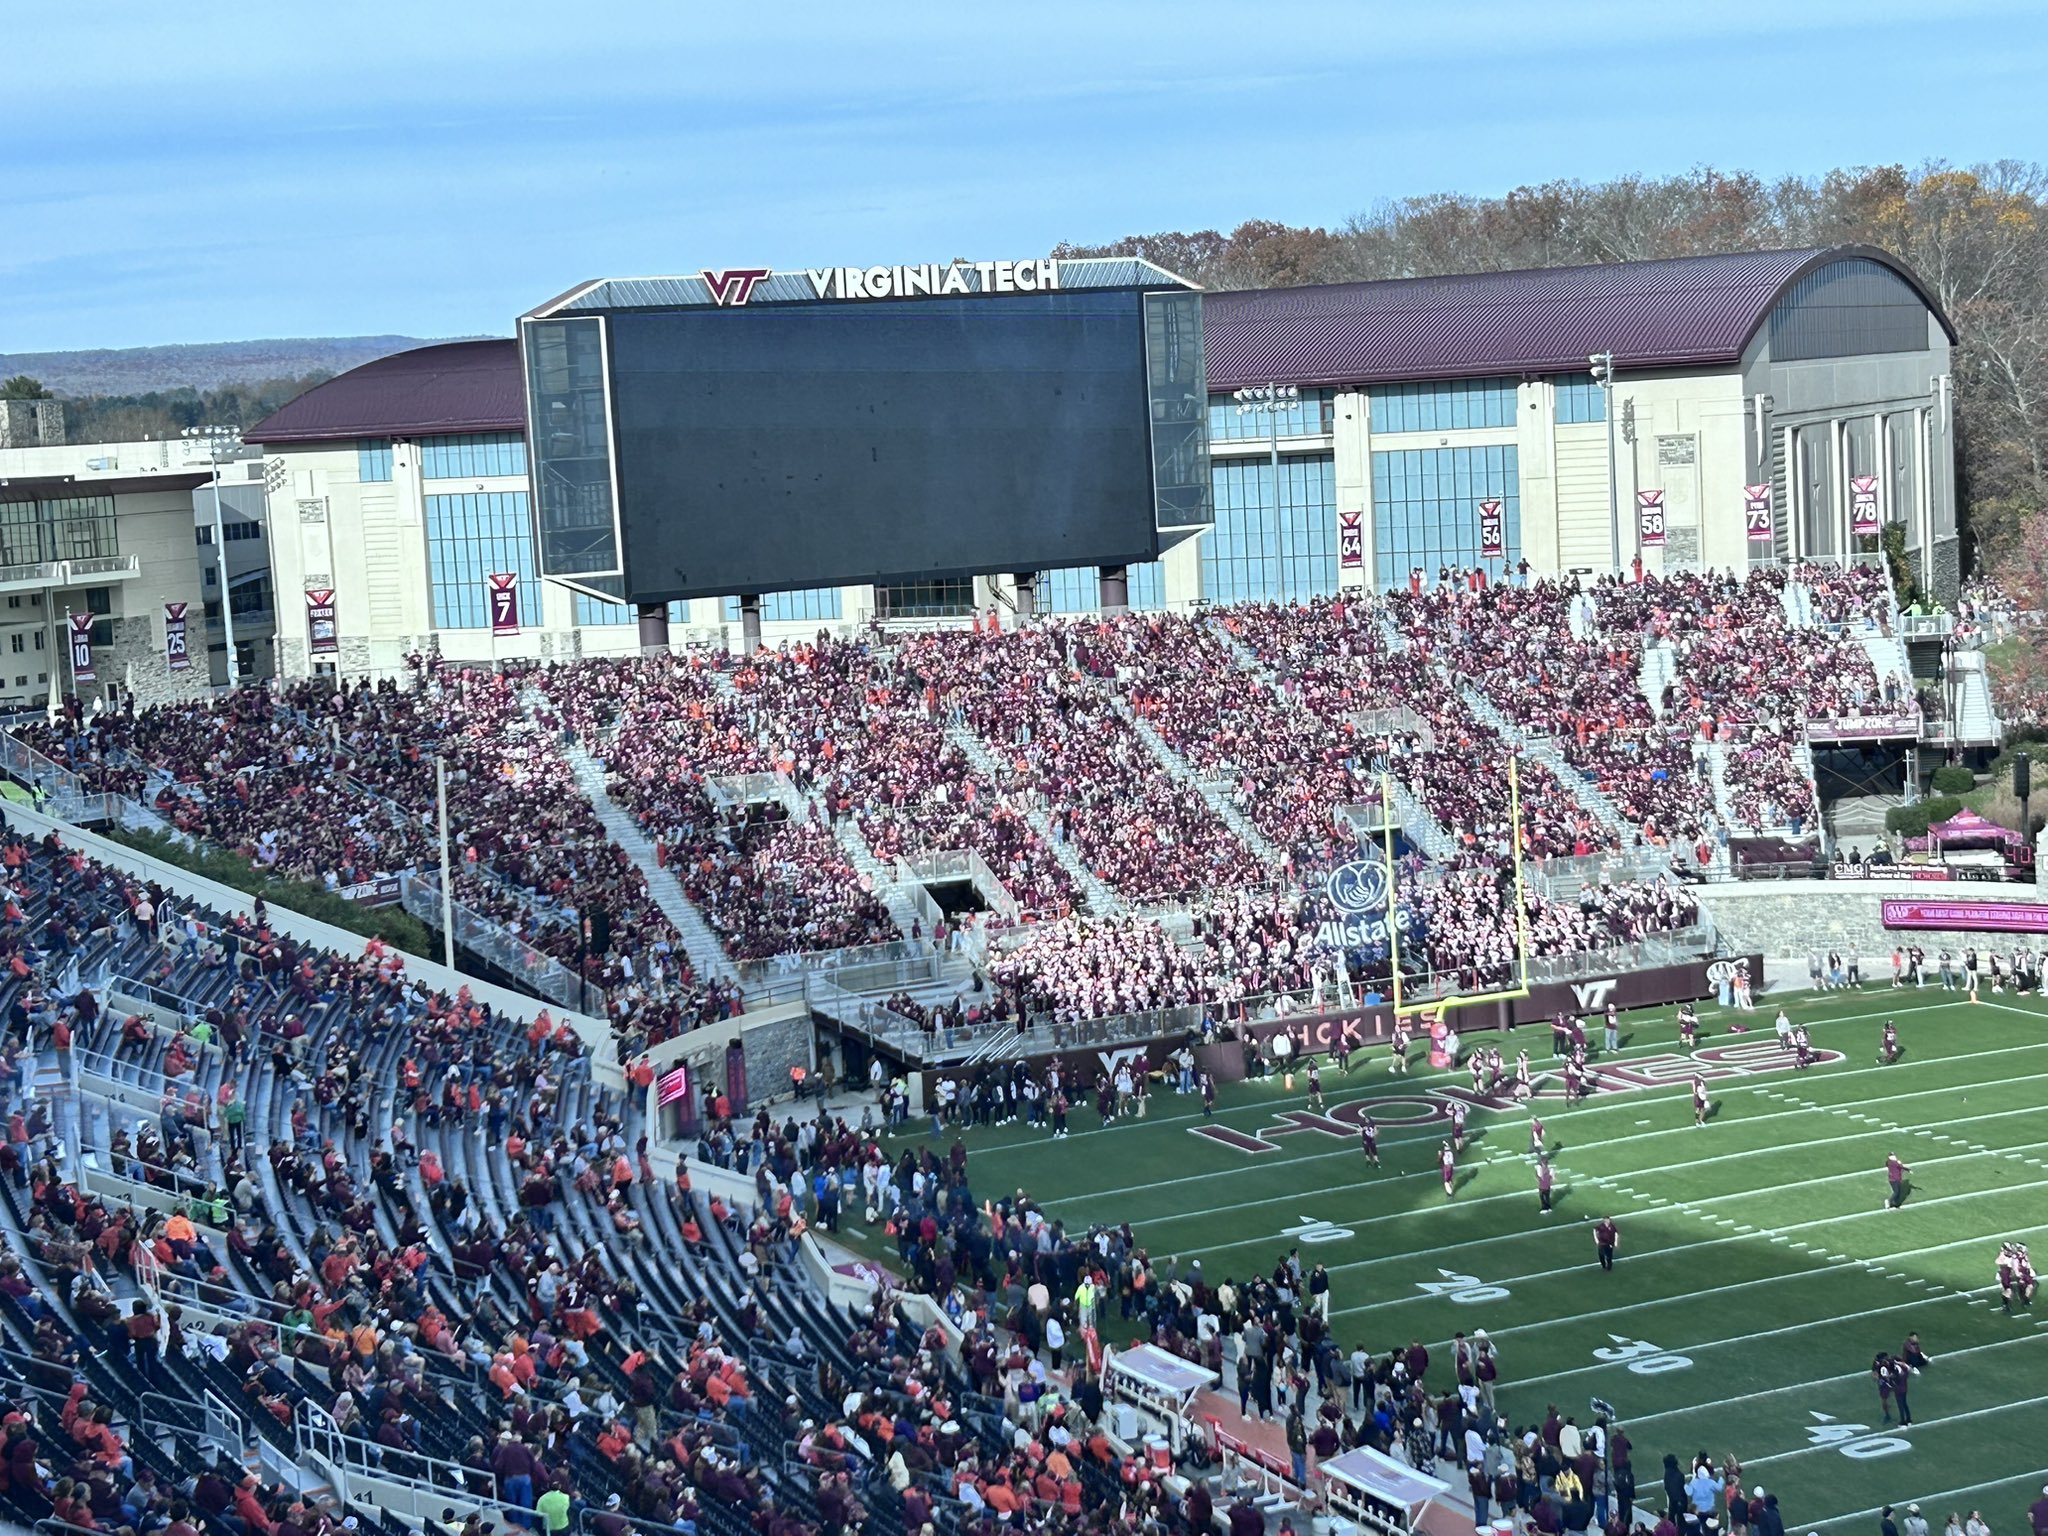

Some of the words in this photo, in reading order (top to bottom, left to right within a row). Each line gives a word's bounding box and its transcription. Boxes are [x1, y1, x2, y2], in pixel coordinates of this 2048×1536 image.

[698, 268, 772, 306] VT
[806, 263, 970, 299] VIRGINIA
[973, 258, 1060, 293] TECH
[1747, 509, 1770, 529] 73
[1854, 502, 1877, 522] 78
[1482, 526, 1500, 545] 56
[1641, 514, 1664, 535] 58
[1342, 537, 1361, 556] 64
[497, 601, 511, 622] 7
[75, 643, 90, 667] 10
[168, 632, 185, 655] 25
[1834, 718, 1865, 730] JUMP
[1865, 717, 1892, 729] ZONE
[1313, 911, 1410, 947] Allstate
[1571, 978, 1617, 1009] VT
[1098, 1046, 1148, 1078] VT
[1280, 1220, 1355, 1243] 10
[1415, 1275, 1511, 1303] 20
[1592, 1340, 1694, 1374] 30
[1804, 1424, 1912, 1459] 40
